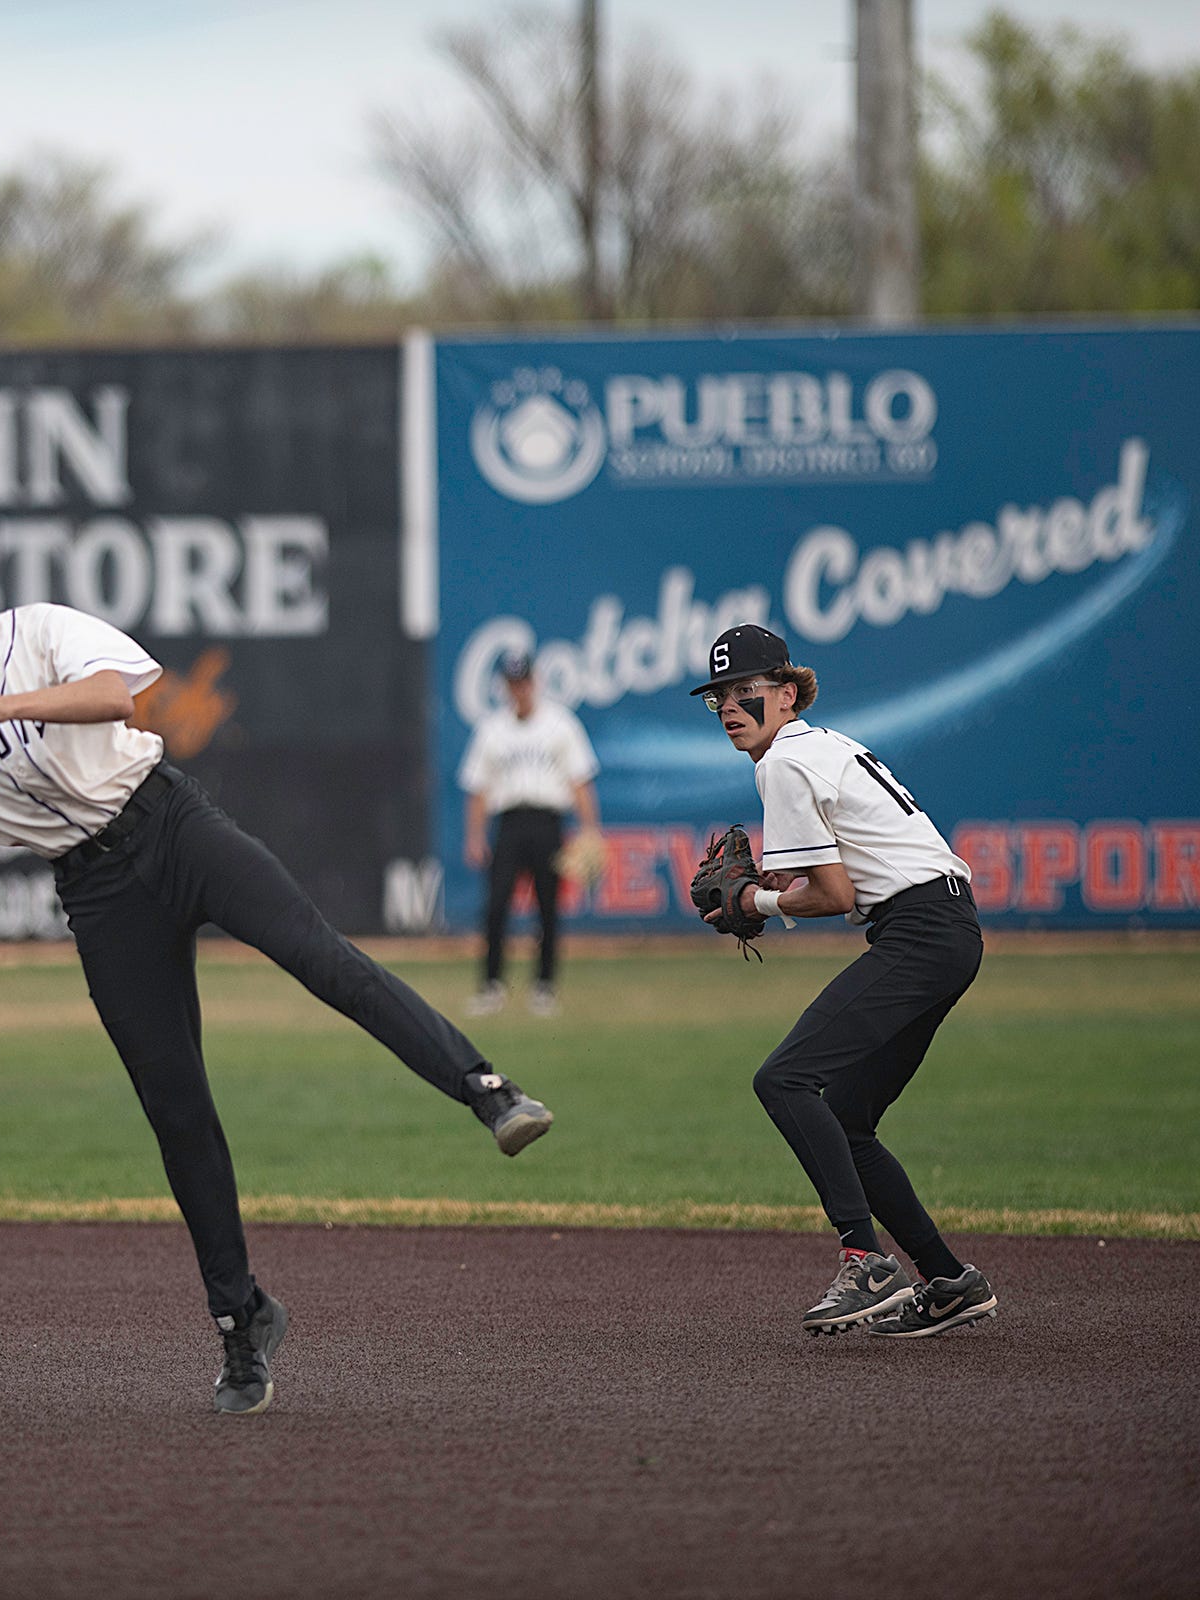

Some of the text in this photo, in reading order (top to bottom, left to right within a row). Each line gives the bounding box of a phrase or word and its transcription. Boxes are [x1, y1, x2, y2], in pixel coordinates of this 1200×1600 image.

[606, 368, 938, 448] PUEBLO
[784, 436, 1154, 643] Covered
[713, 643, 730, 672] S
[854, 752, 923, 816] 1
